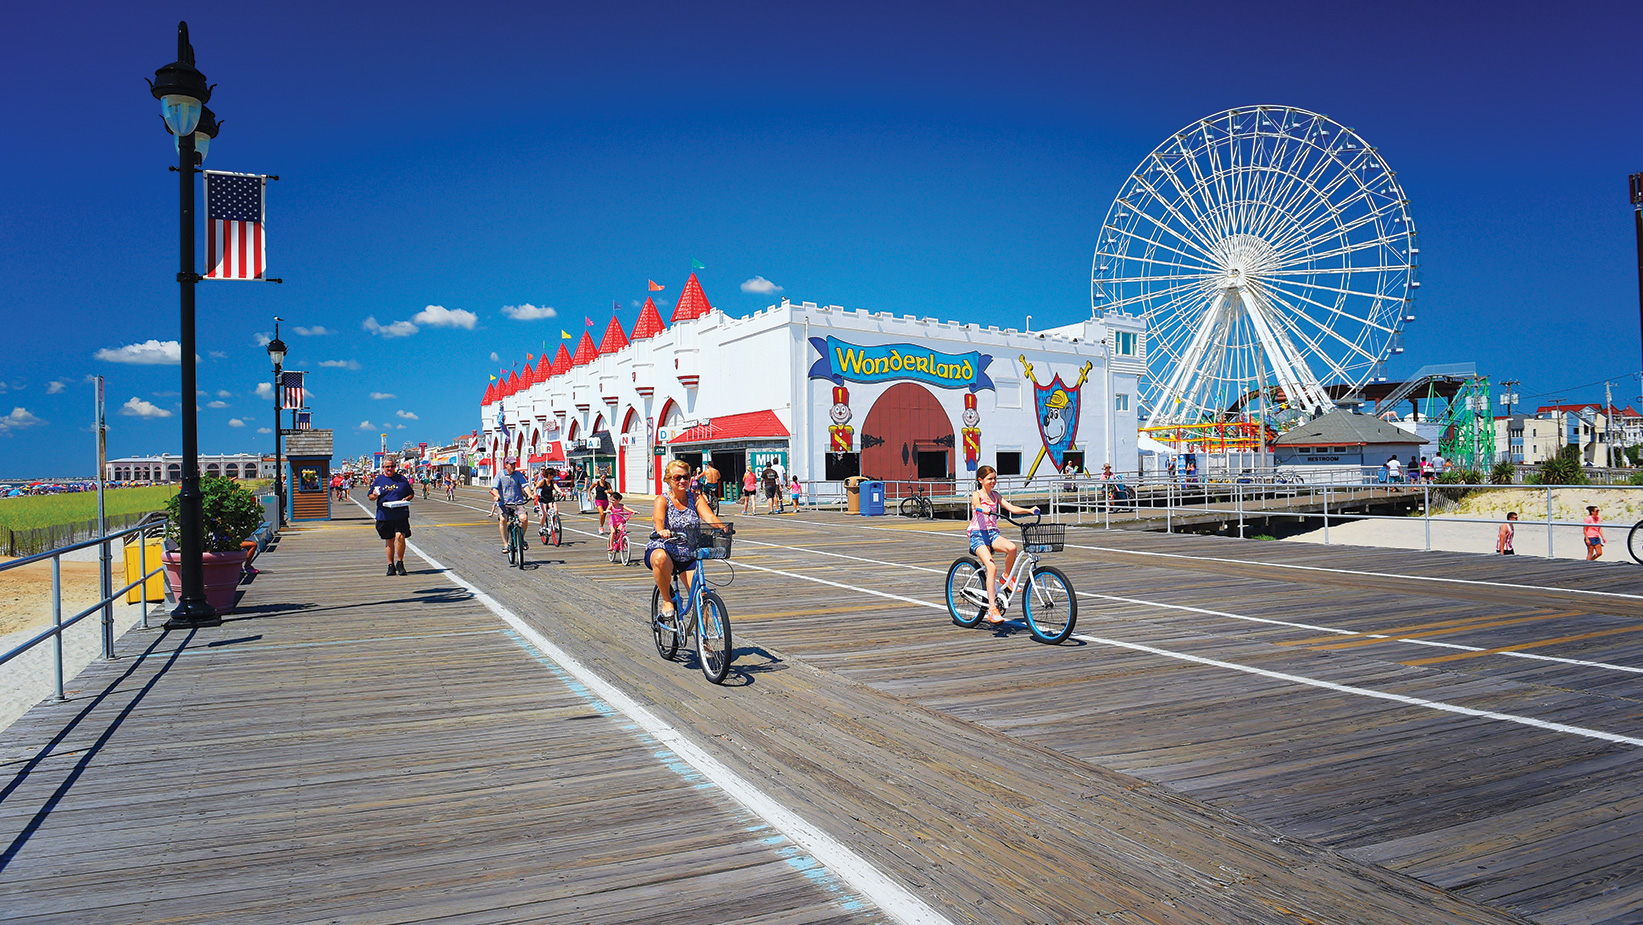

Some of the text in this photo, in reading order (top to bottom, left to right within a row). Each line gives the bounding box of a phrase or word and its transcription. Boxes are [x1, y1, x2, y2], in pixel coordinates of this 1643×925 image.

[836, 347, 974, 380] Wonderland
[660, 430, 667, 439] D
[622, 436, 628, 444] N
